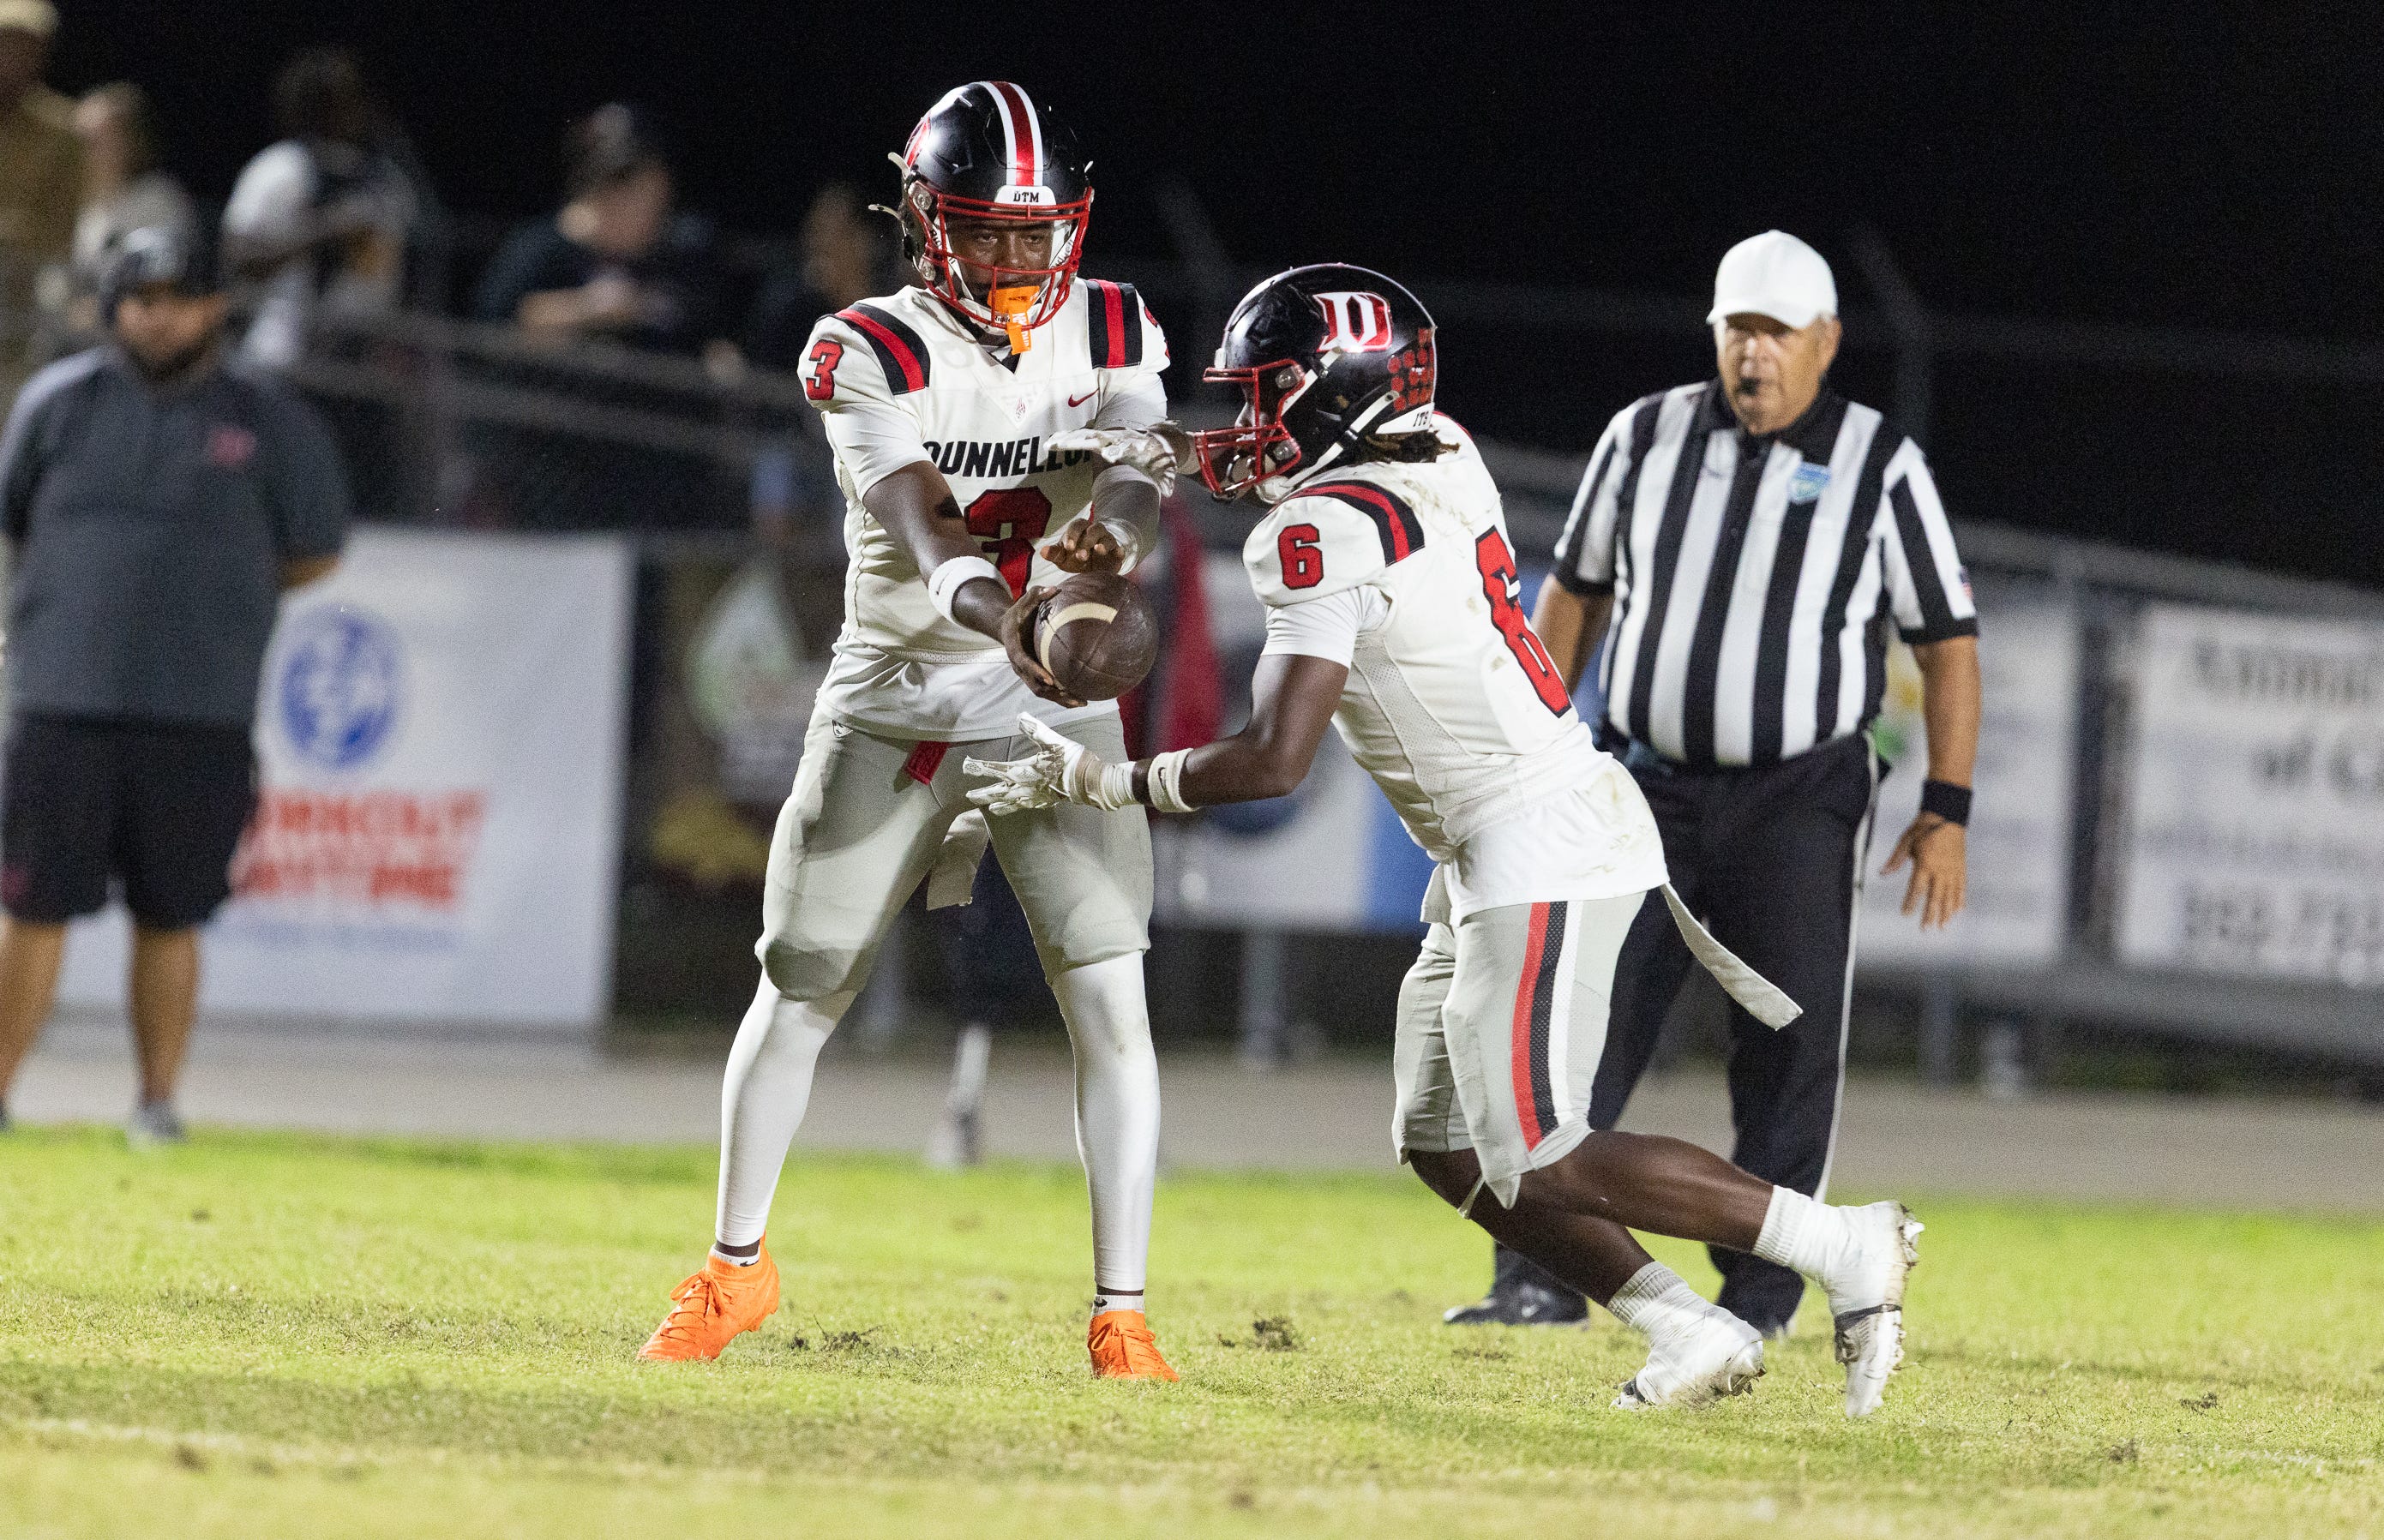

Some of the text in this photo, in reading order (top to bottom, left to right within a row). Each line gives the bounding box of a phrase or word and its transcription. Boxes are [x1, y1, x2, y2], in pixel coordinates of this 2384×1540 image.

[1312, 291, 1392, 353] D
[806, 339, 844, 400] 3
[922, 434, 1092, 477] DUNNELL
[964, 486, 1053, 601] 3
[1277, 523, 1324, 590] 6
[1475, 524, 1572, 718] 6
